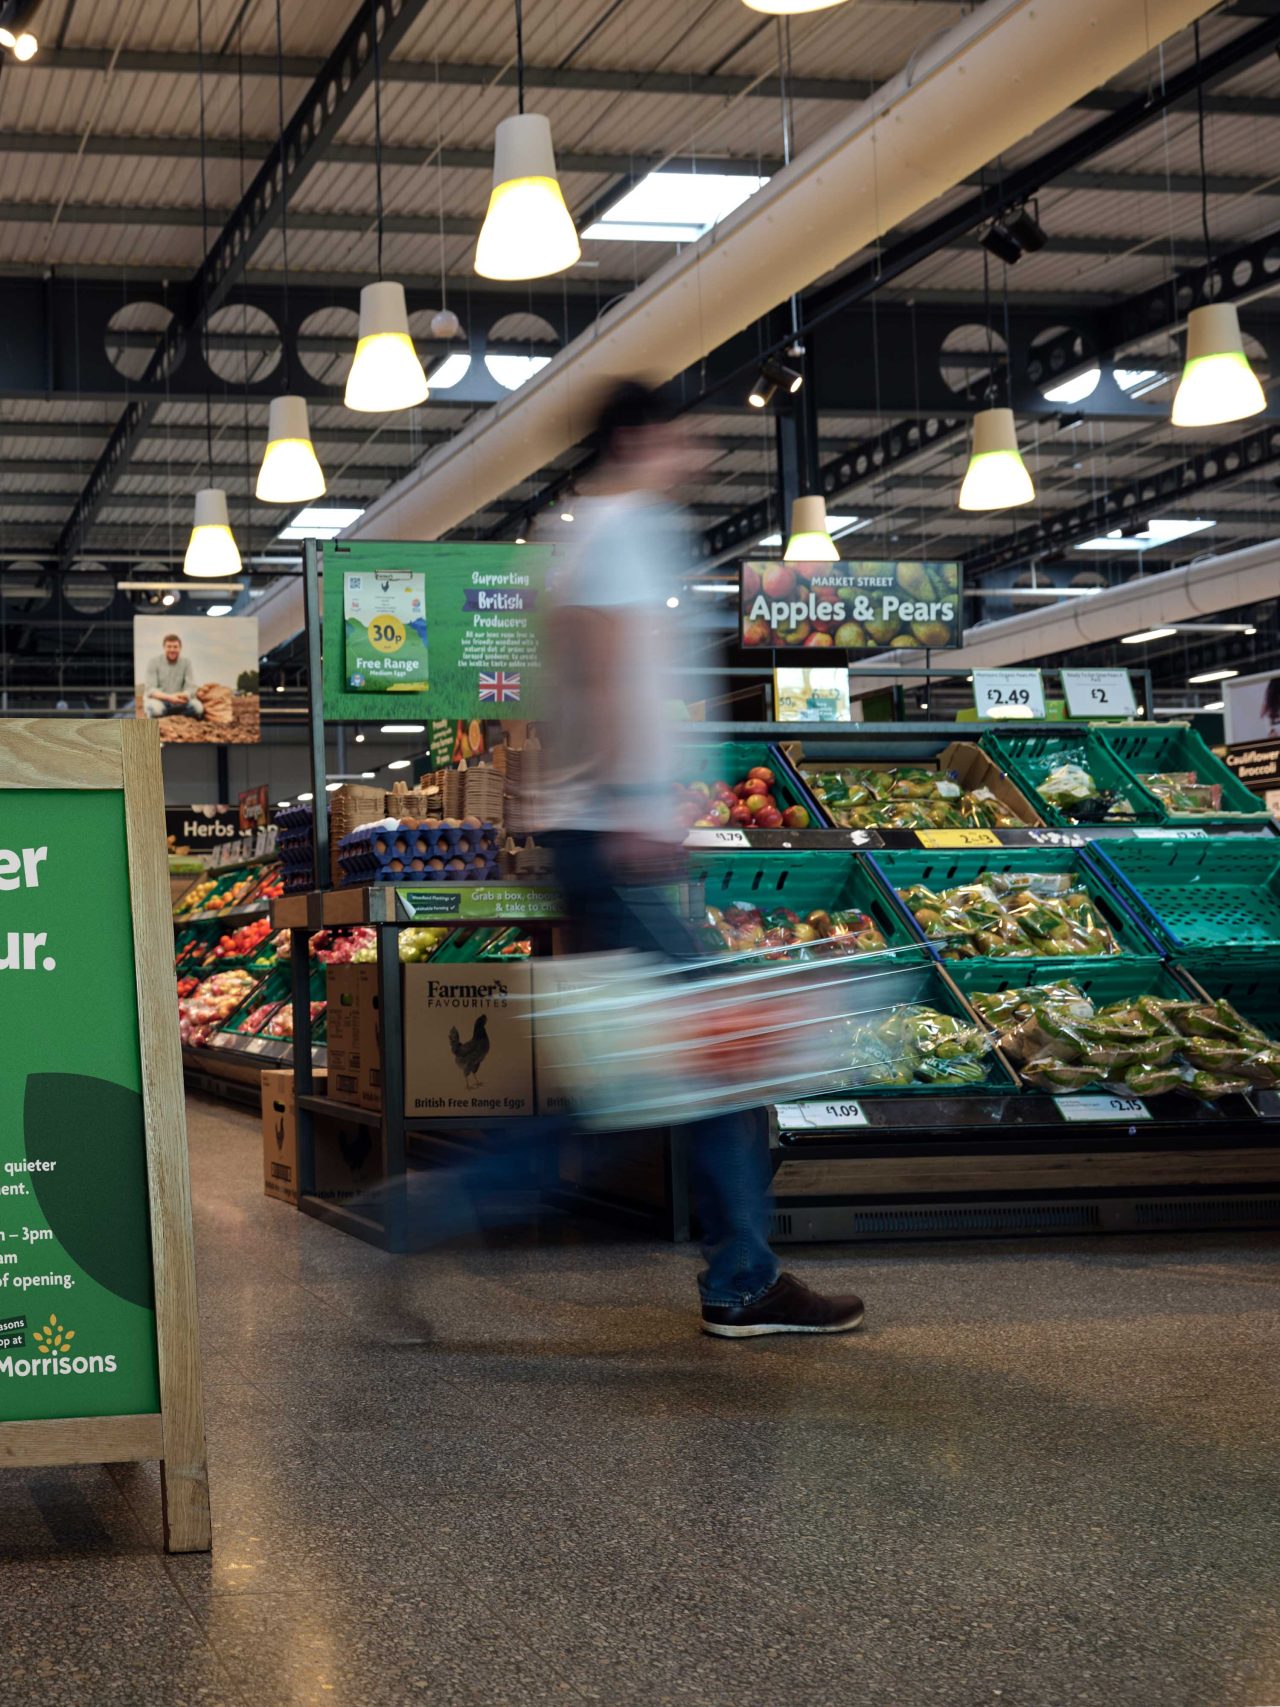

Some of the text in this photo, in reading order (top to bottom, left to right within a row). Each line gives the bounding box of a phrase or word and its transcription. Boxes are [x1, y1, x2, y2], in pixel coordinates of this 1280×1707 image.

[471, 571, 529, 586] Supporting
[811, 577, 894, 587] MARKET STREET
[478, 591, 523, 610] British
[749, 593, 954, 629] Apples & Pears
[473, 614, 527, 628] Producers
[373, 624, 402, 644] 30p
[356, 658, 419, 672] Free Range
[987, 689, 1030, 704] £2.49
[1091, 688, 1109, 703] £2
[1226, 750, 1280, 766] Cauliflower
[1238, 761, 1277, 778] Broccoli
[184, 820, 235, 837] Herbs
[472, 891, 494, 900] Grab
[428, 979, 508, 998] Farmer's
[428, 999, 508, 1008] FAVOURITES
[414, 1098, 525, 1110] British Free Range Eggs
[826, 1104, 859, 1117] £1.09
[1110, 1099, 1142, 1111] £2.15
[4, 1159, 57, 1177] quieter
[22, 1226, 53, 1244] 3pm
[13, 1272, 75, 1291] opening.
[12, 1335, 23, 1345] at
